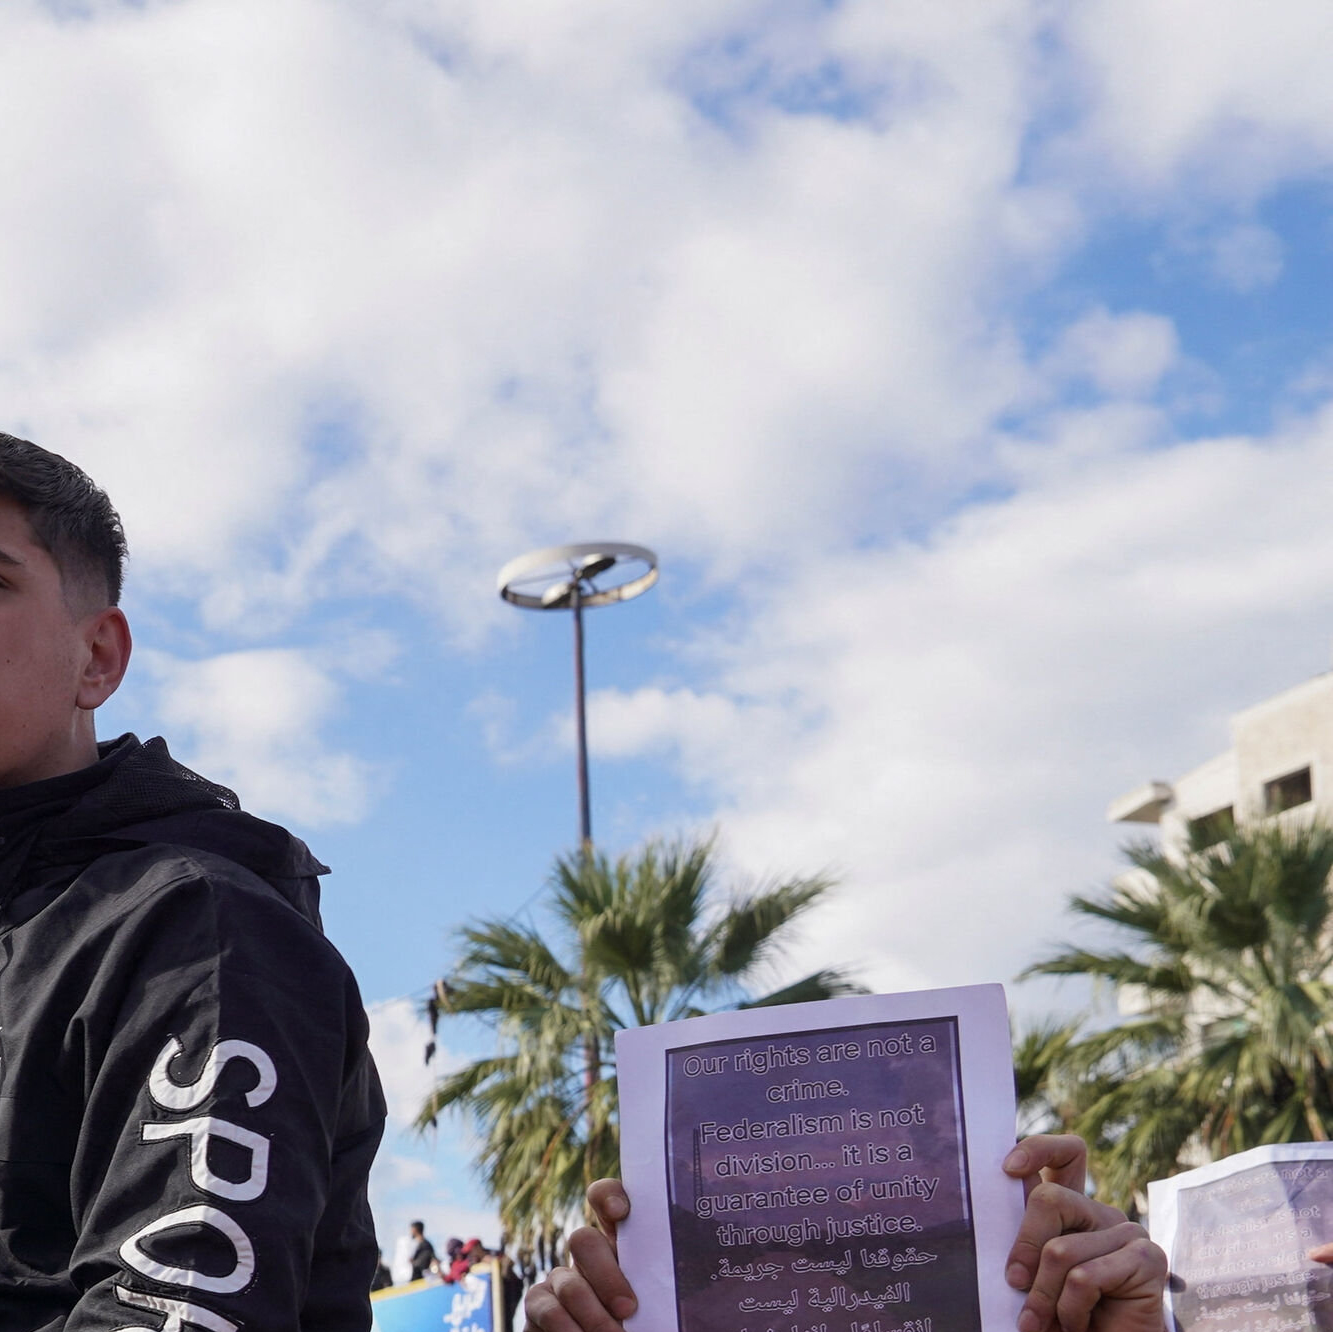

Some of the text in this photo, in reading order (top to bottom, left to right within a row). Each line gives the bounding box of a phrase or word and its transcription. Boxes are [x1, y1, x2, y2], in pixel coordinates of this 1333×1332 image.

[683, 1032, 937, 1078] Our rights are not a
[766, 1078, 849, 1104] crime.
[700, 1103, 924, 1145] Federalism is not
[715, 1143, 912, 1178] division... it is a
[695, 1175, 939, 1219] guarantee of unity
[716, 1213, 923, 1247] through justice.
[711, 1247, 938, 1281] حقوقنا ليست جريمة.
[739, 1282, 910, 1314] الفيدرالية ليست
